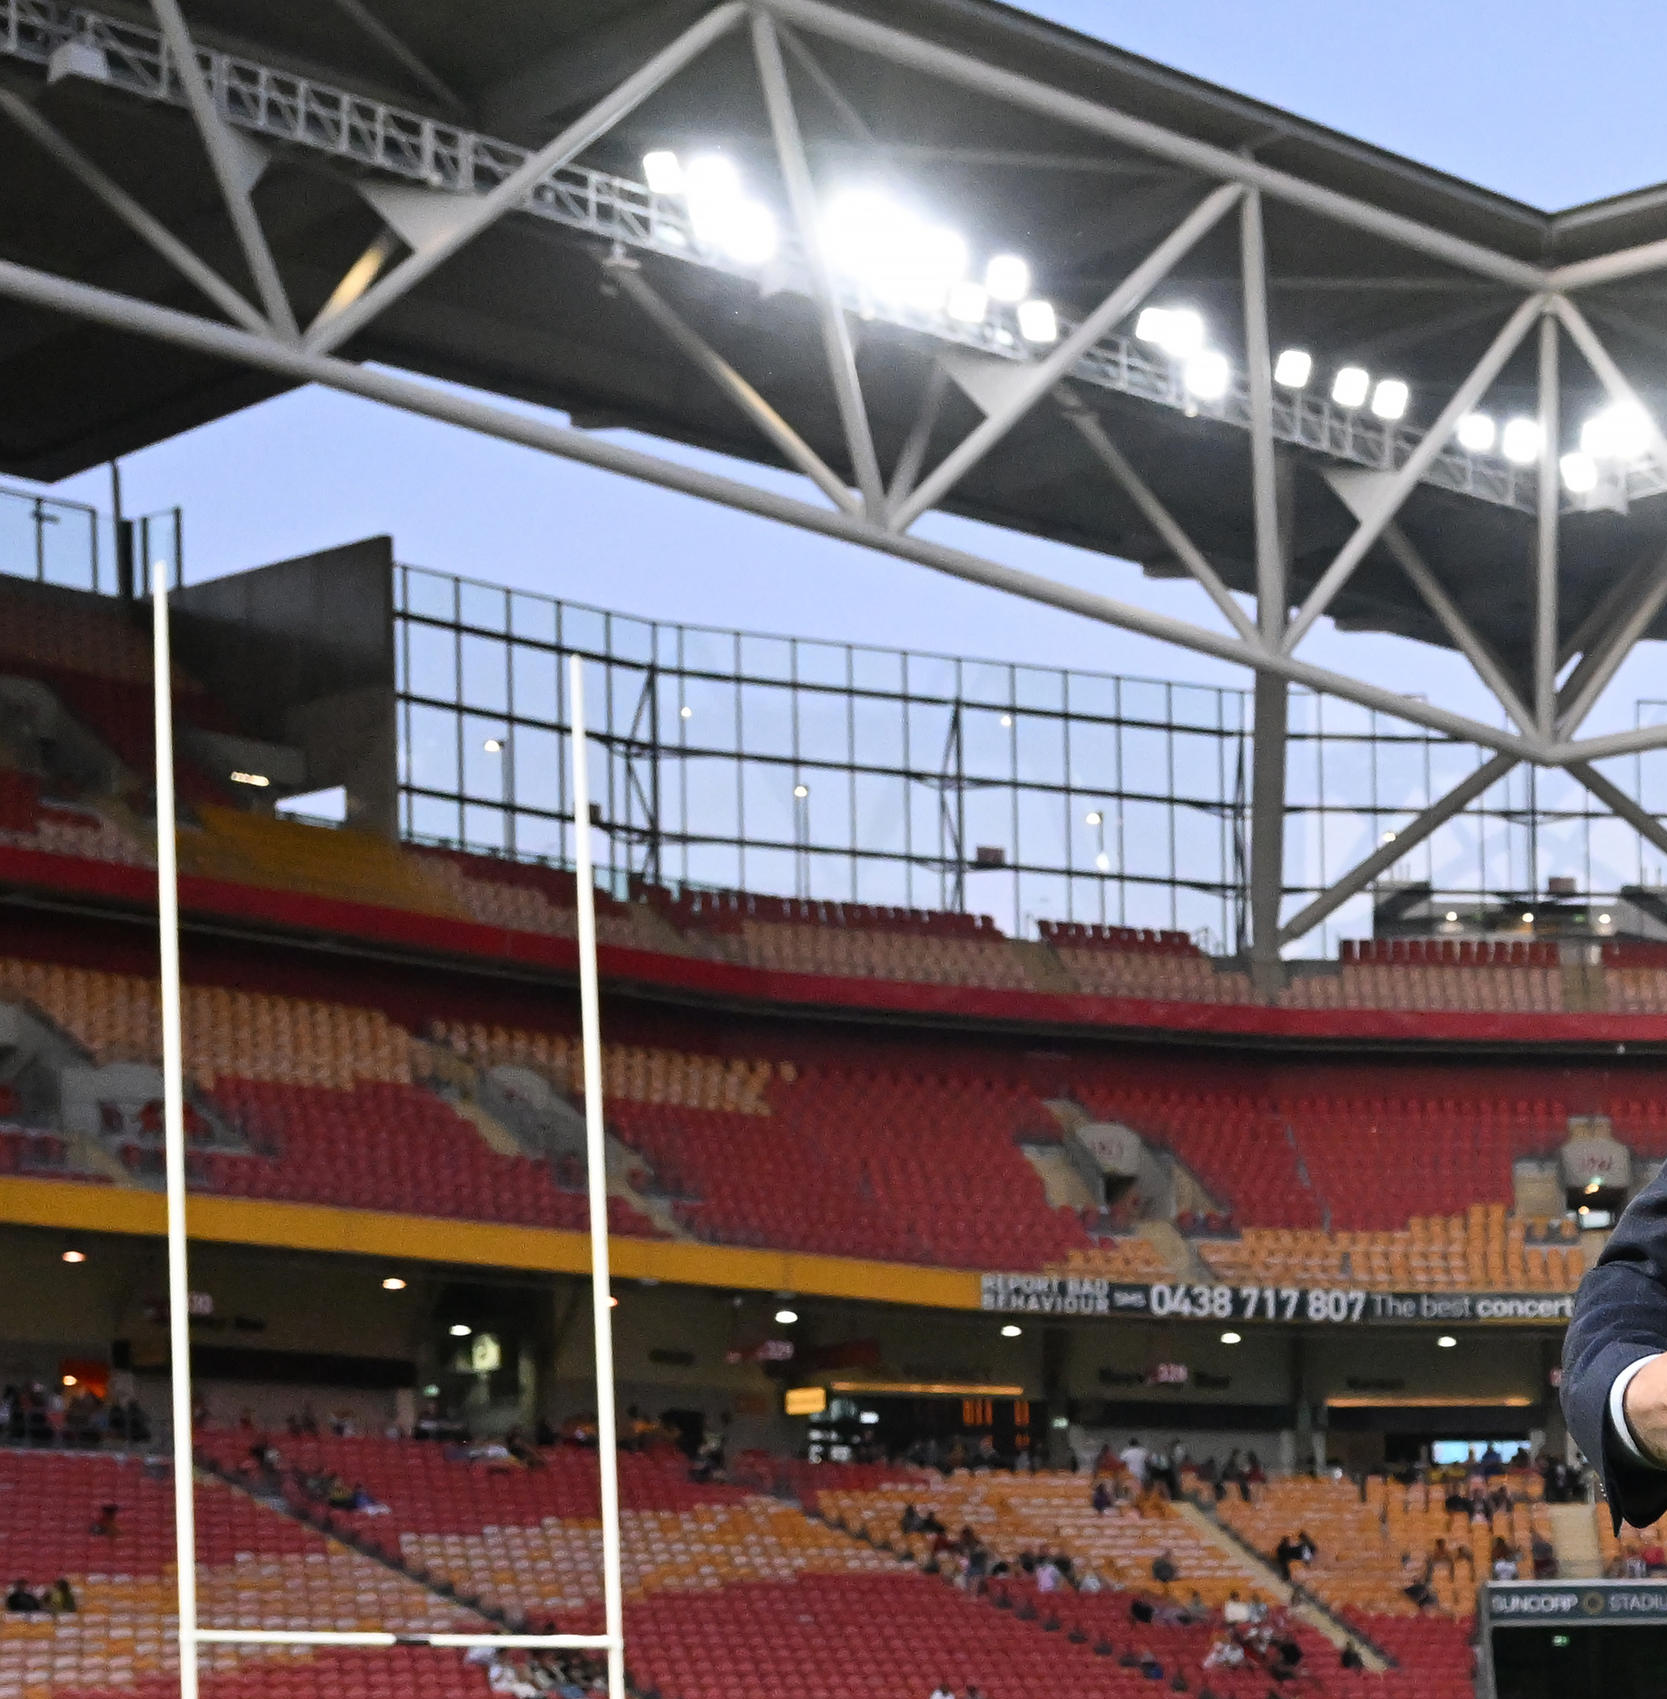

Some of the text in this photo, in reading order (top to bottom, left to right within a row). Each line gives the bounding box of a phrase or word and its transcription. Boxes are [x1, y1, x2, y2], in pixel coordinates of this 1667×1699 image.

[1151, 1284, 1232, 1318] 0438
[1240, 1286, 1299, 1320] 717
[1308, 1288, 1366, 1322] 807
[1370, 1294, 1416, 1318] The
[1421, 1294, 1472, 1318] best
[1491, 1592, 1578, 1613] SUNCORP
